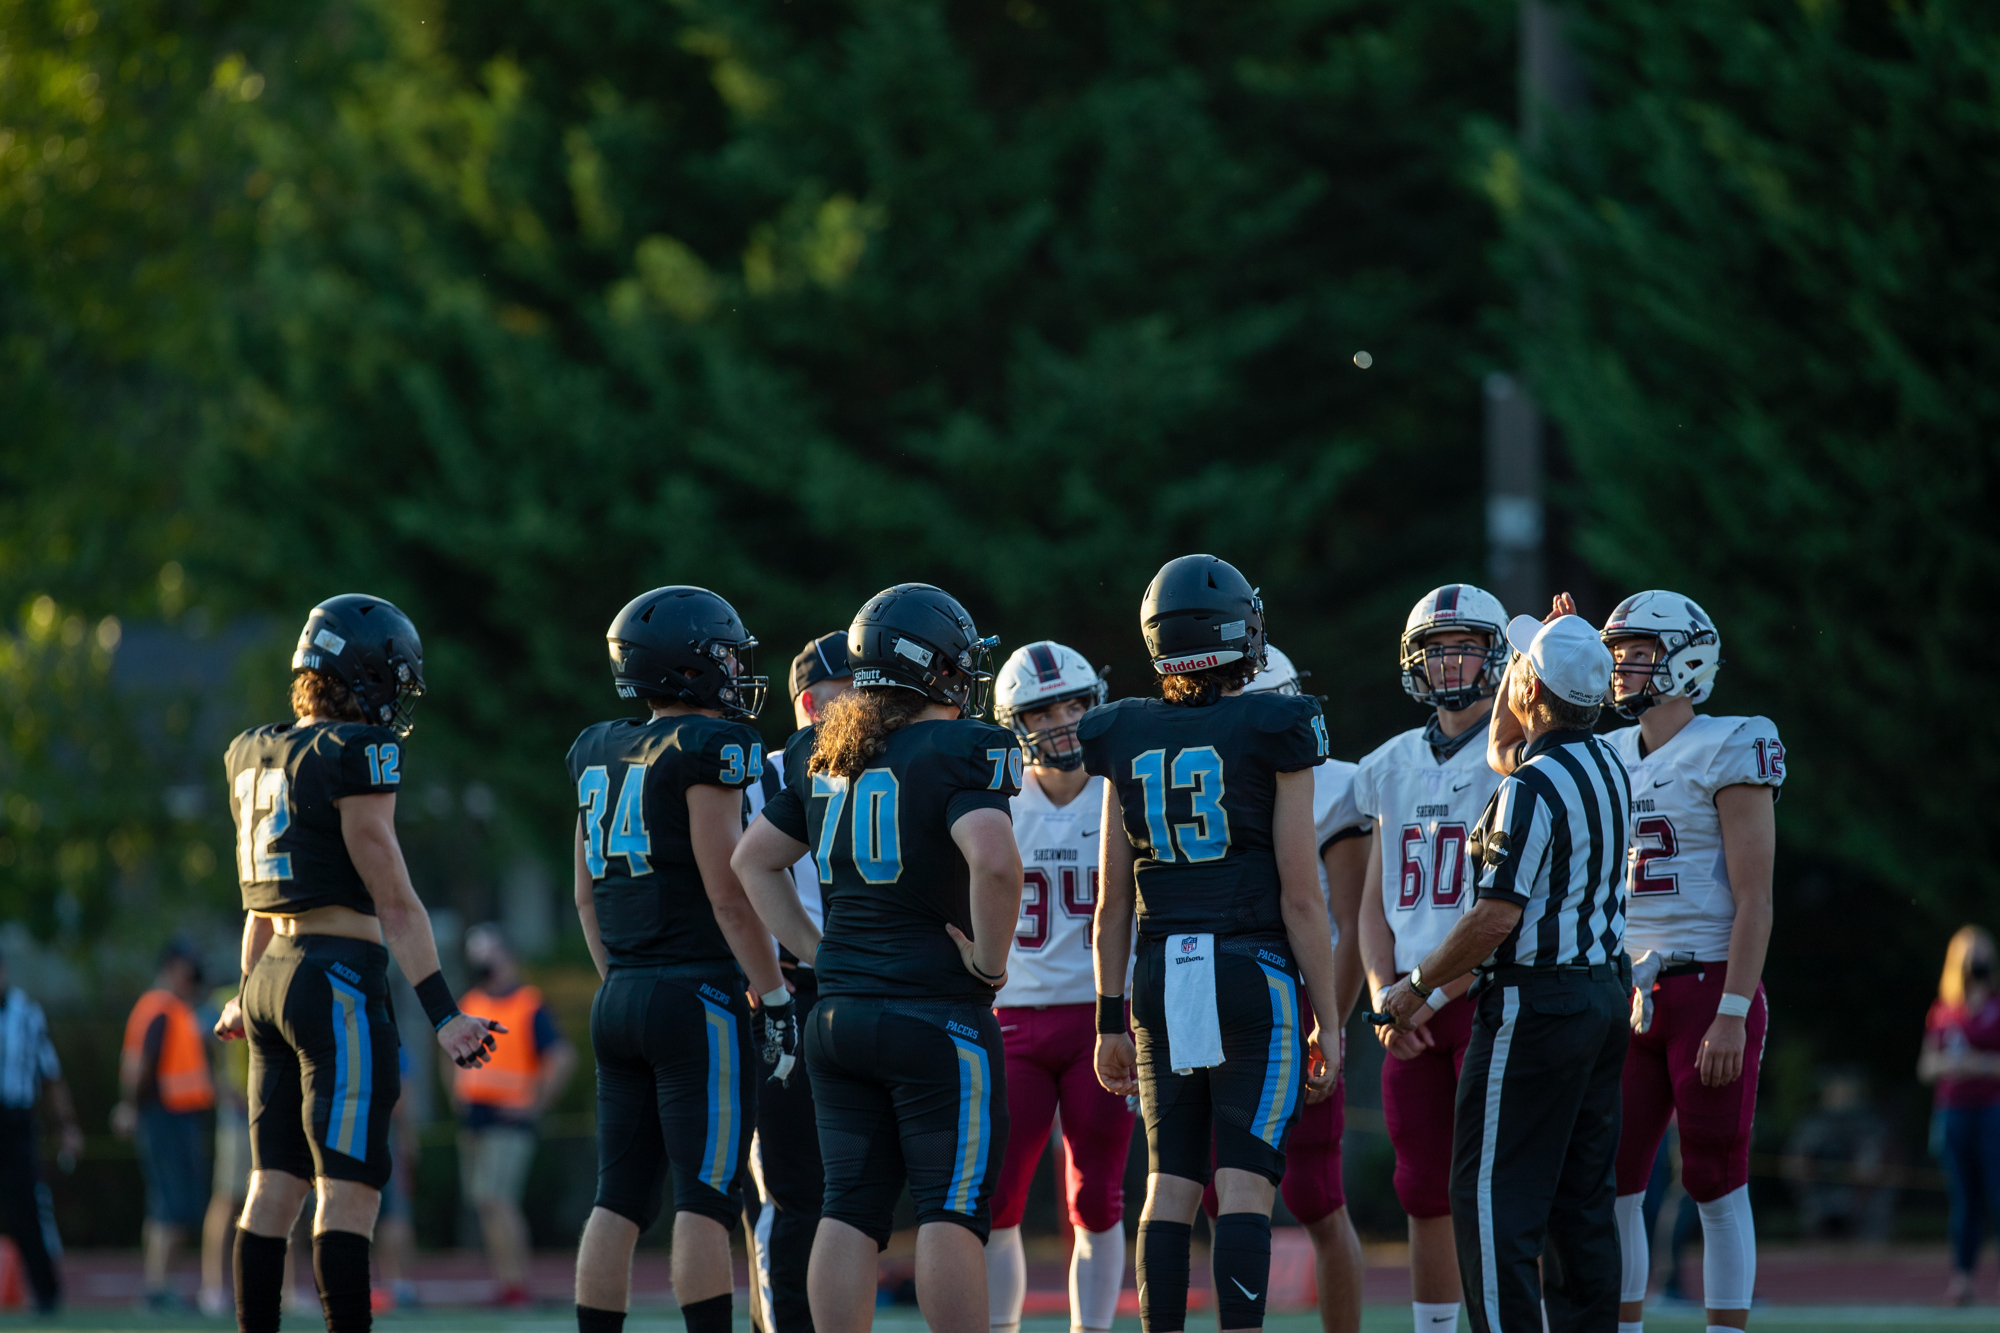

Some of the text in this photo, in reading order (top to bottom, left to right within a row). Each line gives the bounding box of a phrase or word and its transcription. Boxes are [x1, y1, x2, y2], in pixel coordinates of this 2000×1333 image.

[1162, 654, 1219, 673] Riddell
[364, 743, 401, 786] 12
[718, 743, 764, 785] 34
[986, 747, 1023, 790] 70
[1752, 737, 1785, 779] 12
[234, 767, 295, 883] 12
[577, 763, 655, 880] 34
[1131, 745, 1232, 864] 13
[1416, 804, 1449, 818] SHERWOOD
[811, 767, 905, 885] 70
[1033, 848, 1078, 861] SHERWOOD
[1396, 821, 1470, 912] 60
[1631, 815, 1680, 898] 2
[1012, 866, 1099, 953] 34
[1175, 955, 1203, 965] Wilson
[1182, 943, 1196, 952] NFL
[1256, 948, 1287, 968] PACERS
[330, 961, 362, 985] PACERS
[699, 982, 731, 1005] PACERS
[945, 1020, 979, 1040] PACERS
